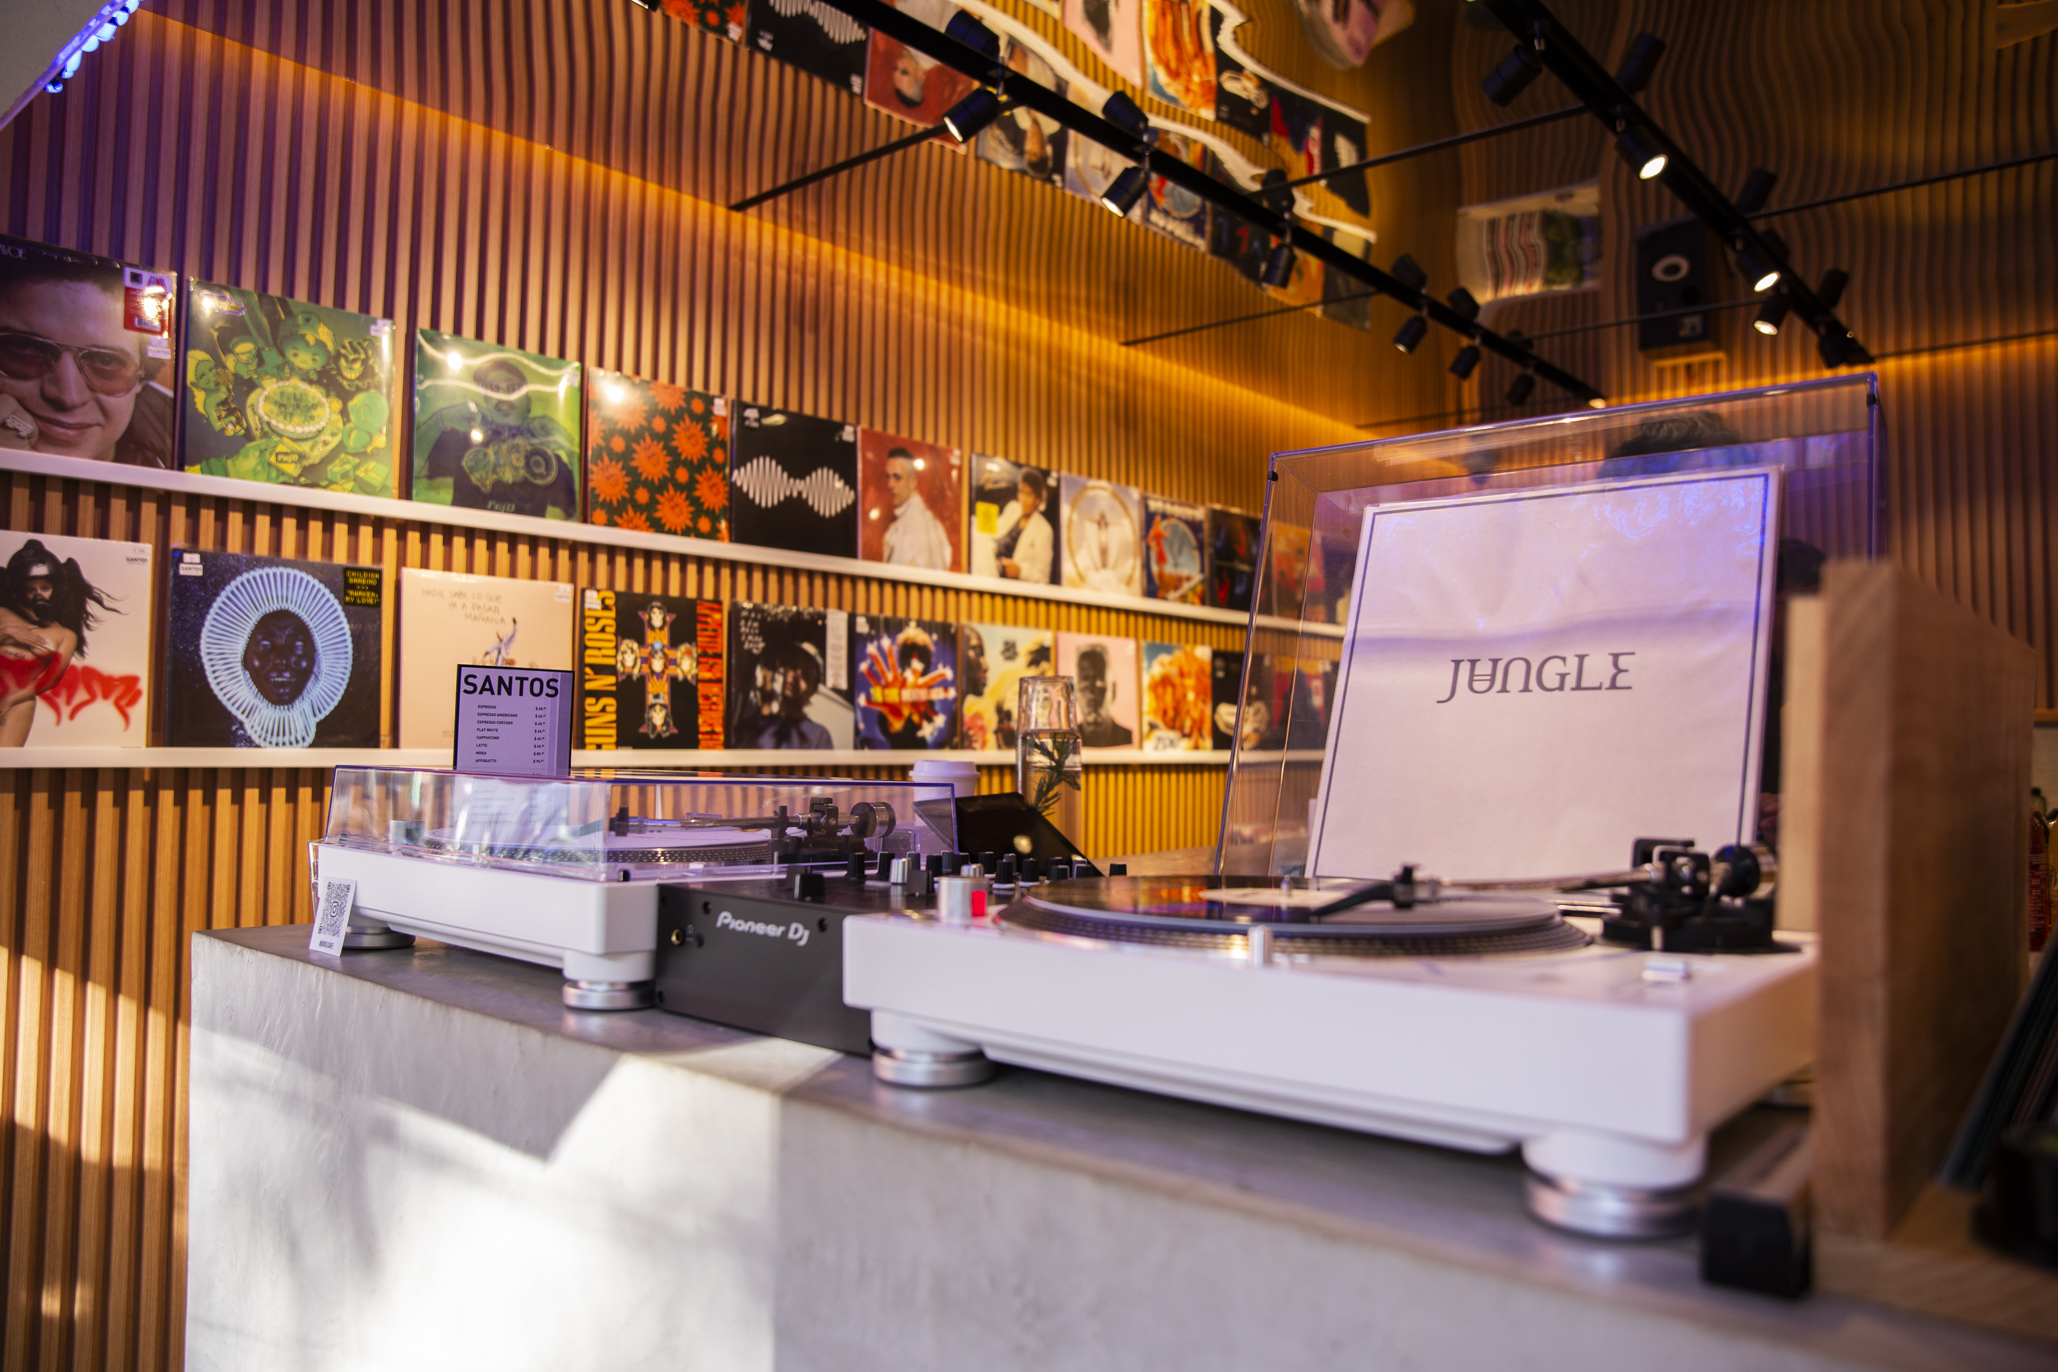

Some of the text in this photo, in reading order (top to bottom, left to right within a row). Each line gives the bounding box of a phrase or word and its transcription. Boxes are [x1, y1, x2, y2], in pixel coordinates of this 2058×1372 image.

[462, 674, 559, 698] SANTOS
[1436, 652, 1636, 704] JUNGLE
[715, 910, 786, 937] Pioneer
